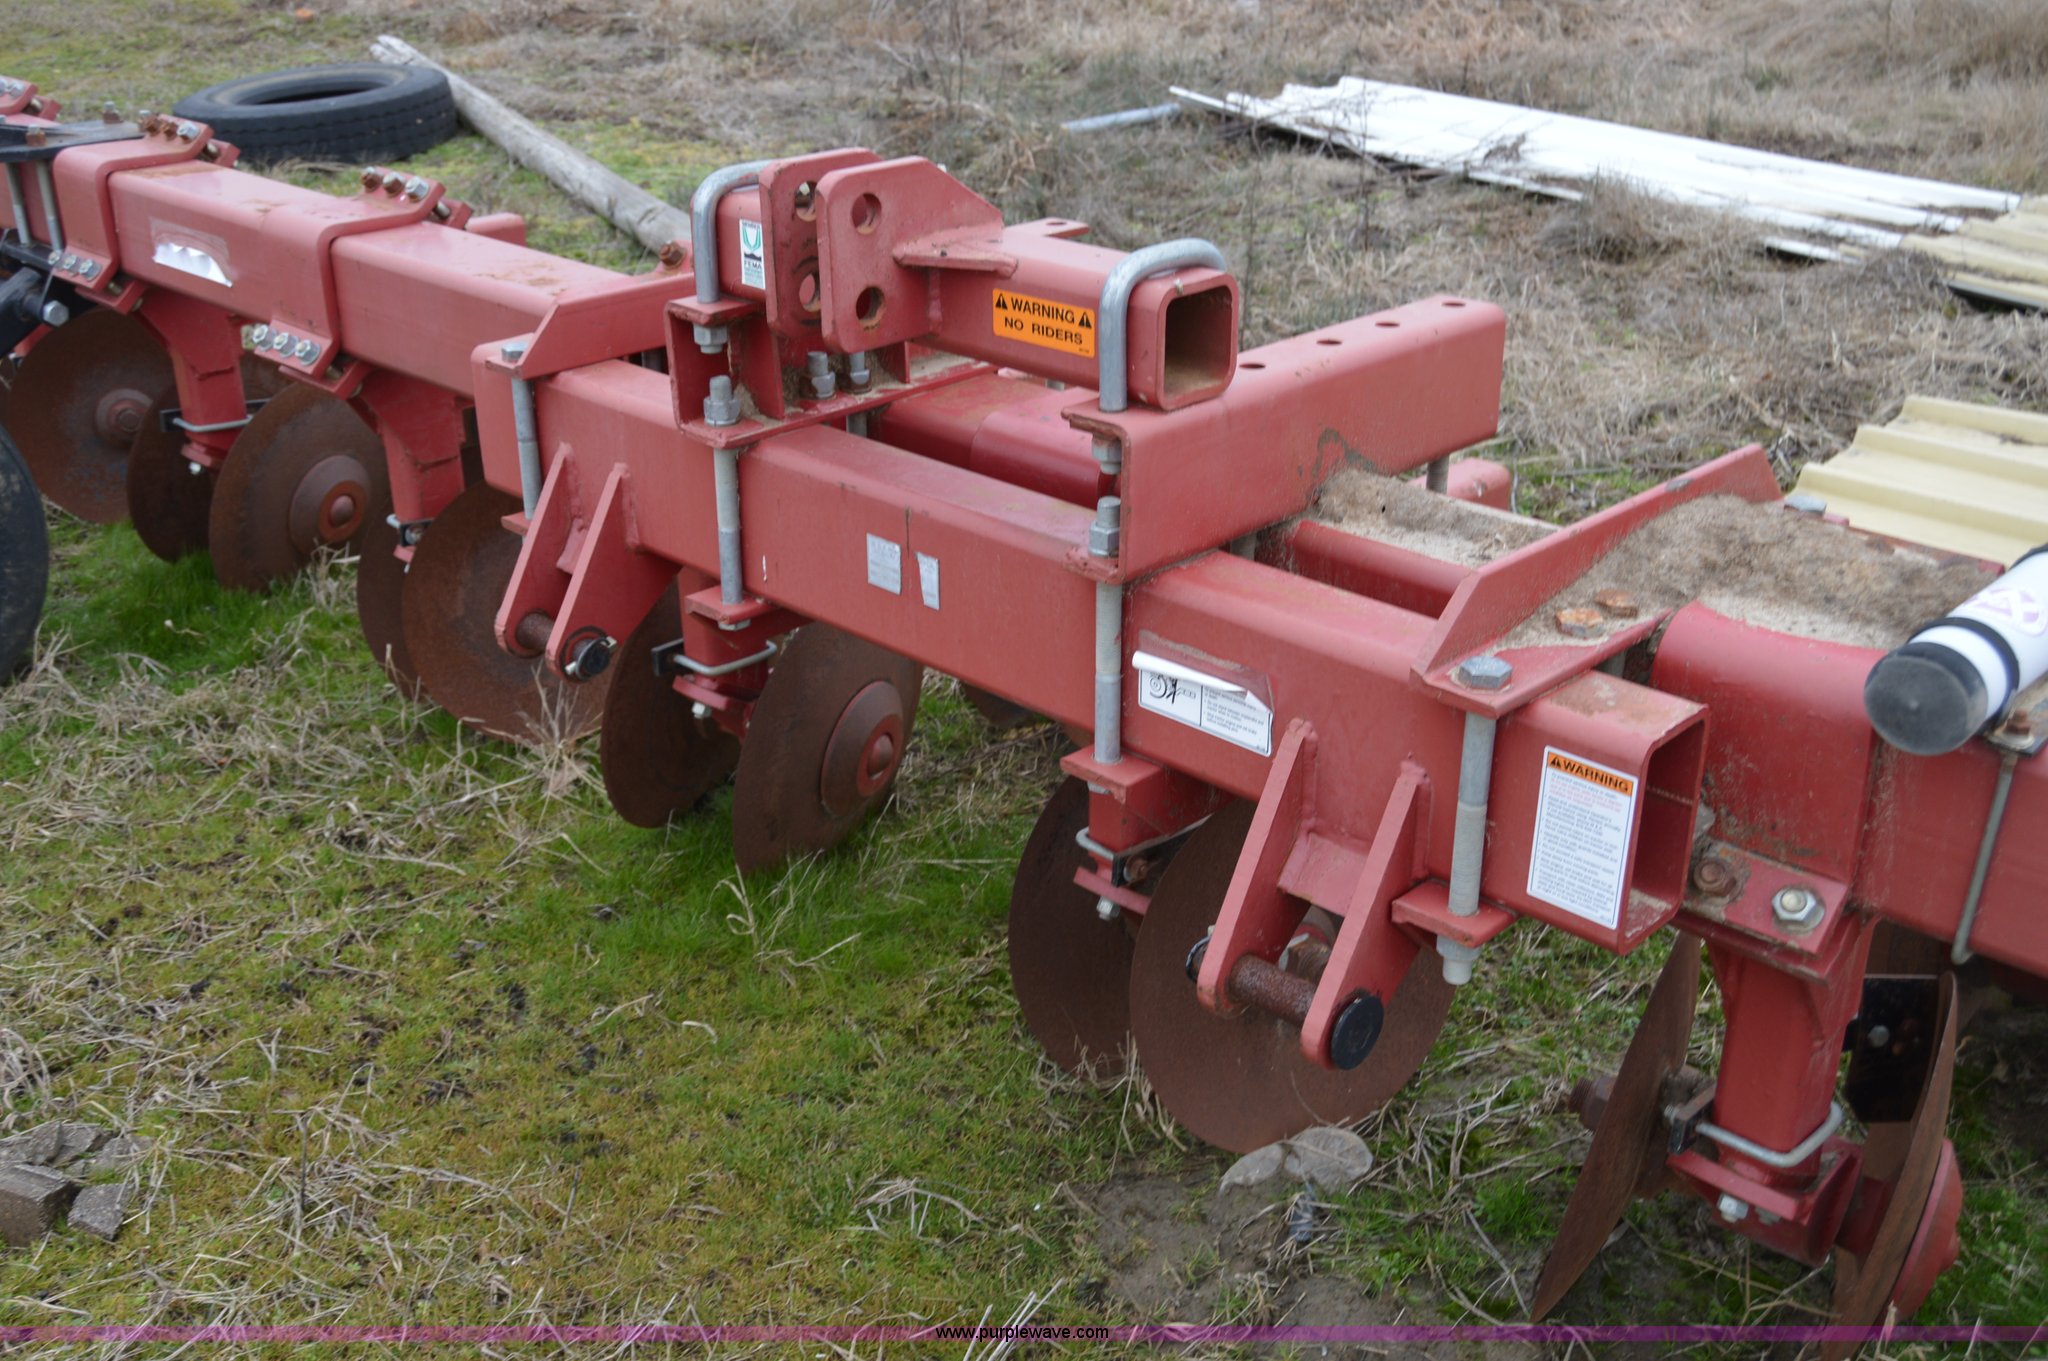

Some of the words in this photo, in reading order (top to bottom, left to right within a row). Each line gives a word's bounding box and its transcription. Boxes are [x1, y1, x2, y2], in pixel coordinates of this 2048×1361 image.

[744, 260, 762, 270] FEMA
[1010, 297, 1075, 324] WARNING
[1004, 317, 1024, 331] NO
[1031, 323, 1083, 345] RIDERS
[1563, 760, 1628, 793] WARNING
